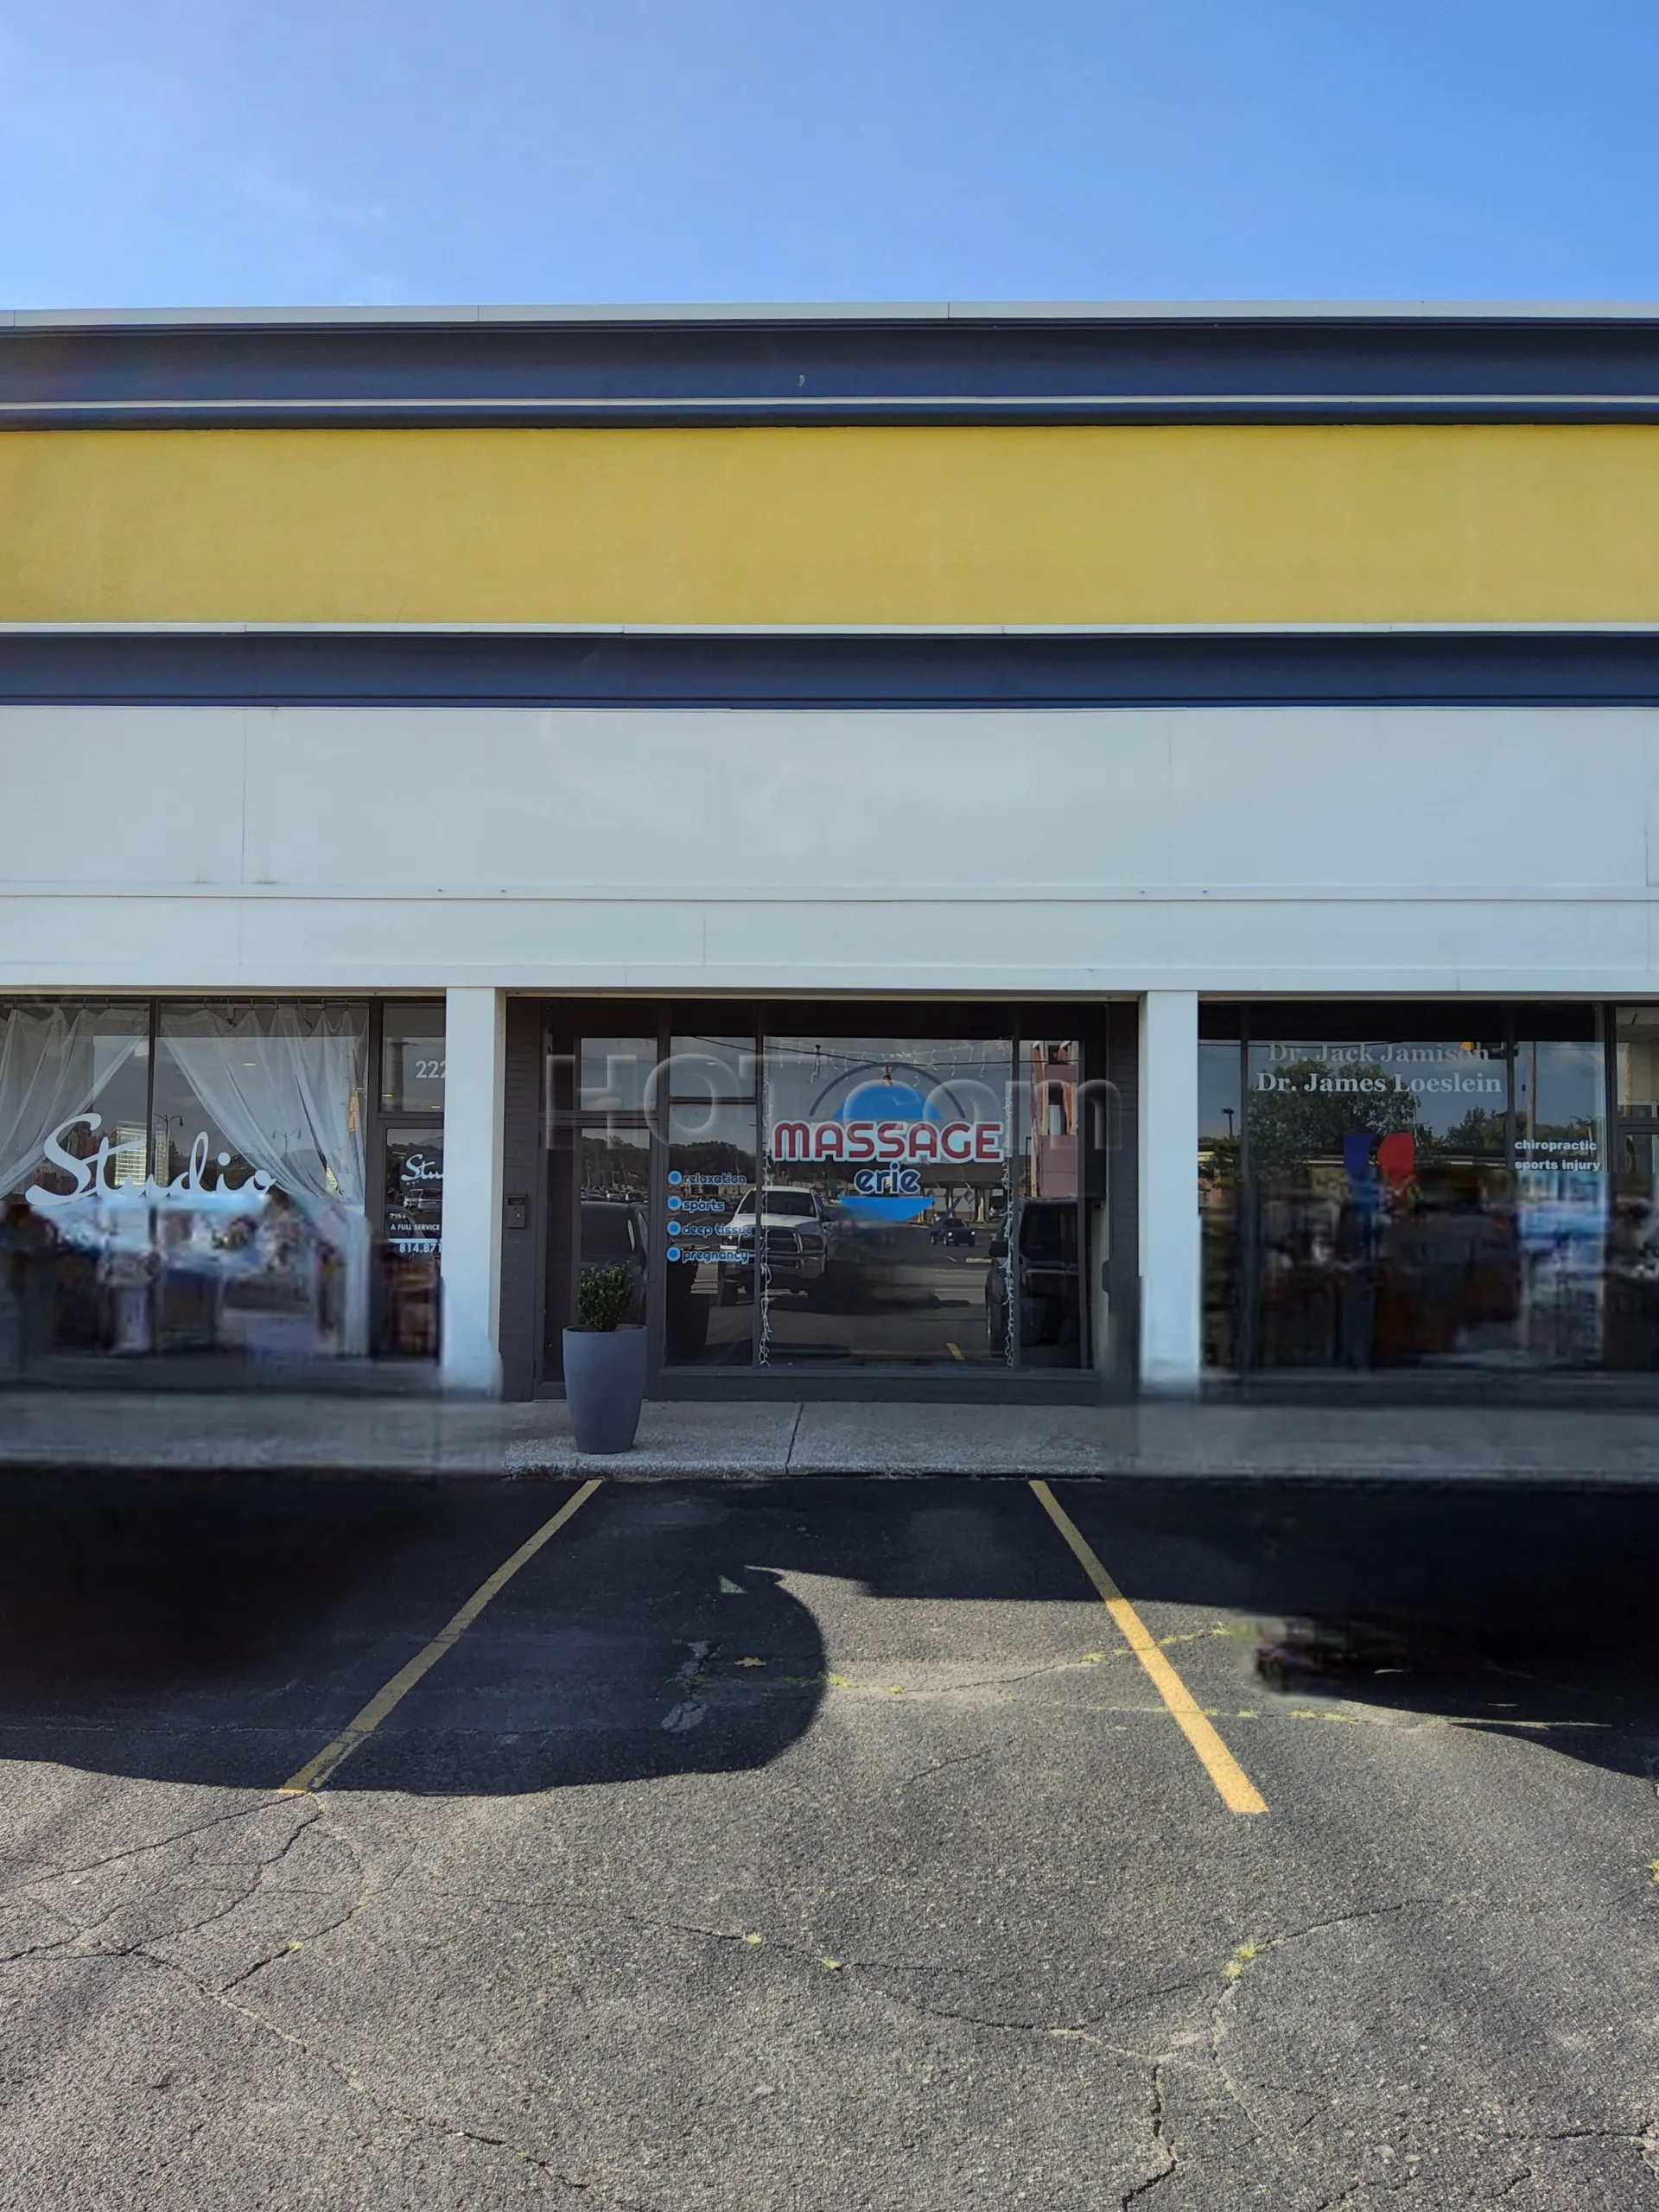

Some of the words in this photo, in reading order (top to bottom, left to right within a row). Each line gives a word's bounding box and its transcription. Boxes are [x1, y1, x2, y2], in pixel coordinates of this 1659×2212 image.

[1269, 1044, 1307, 1062] Dr.
[1314, 1044, 1370, 1062] Jack
[1380, 1044, 1489, 1062] Jamison
[1256, 1073, 1296, 1091] Dr.
[1304, 1073, 1386, 1091] James
[1393, 1072, 1502, 1092] Loeslein
[772, 1121, 1004, 1160] MASSAGE
[1514, 1140, 1597, 1152] chiropractic
[25, 1112, 276, 1205] Studio
[1514, 1159, 1558, 1171] sports
[1561, 1159, 1601, 1172] injury
[683, 1173, 747, 1185] relaxation
[854, 1162, 922, 1193] erie
[682, 1199, 725, 1213] sports
[682, 1224, 713, 1237] deep
[715, 1224, 753, 1236] tissue
[683, 1250, 749, 1264] pregnancy
